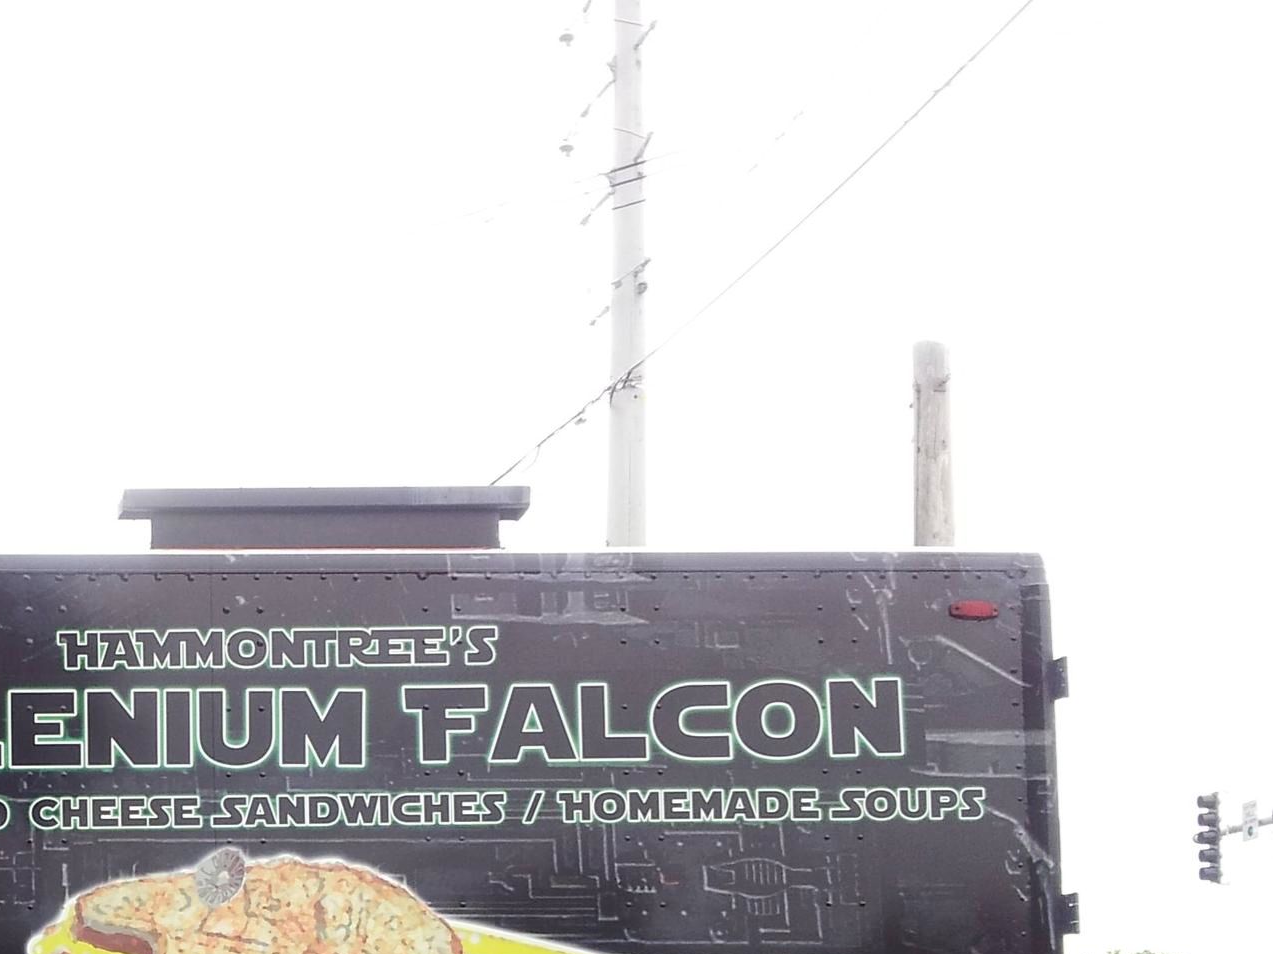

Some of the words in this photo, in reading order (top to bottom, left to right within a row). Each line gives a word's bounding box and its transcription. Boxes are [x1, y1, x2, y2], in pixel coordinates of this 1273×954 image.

[56, 625, 498, 669] HAMMONTREE'S
[403, 677, 906, 763] FALCON
[30, 796, 203, 831] CHEESE
[210, 790, 506, 829] SANDWICHES
[522, 790, 544, 824] /
[558, 787, 820, 825] HOMEMADE
[831, 786, 985, 821] SOUPS
